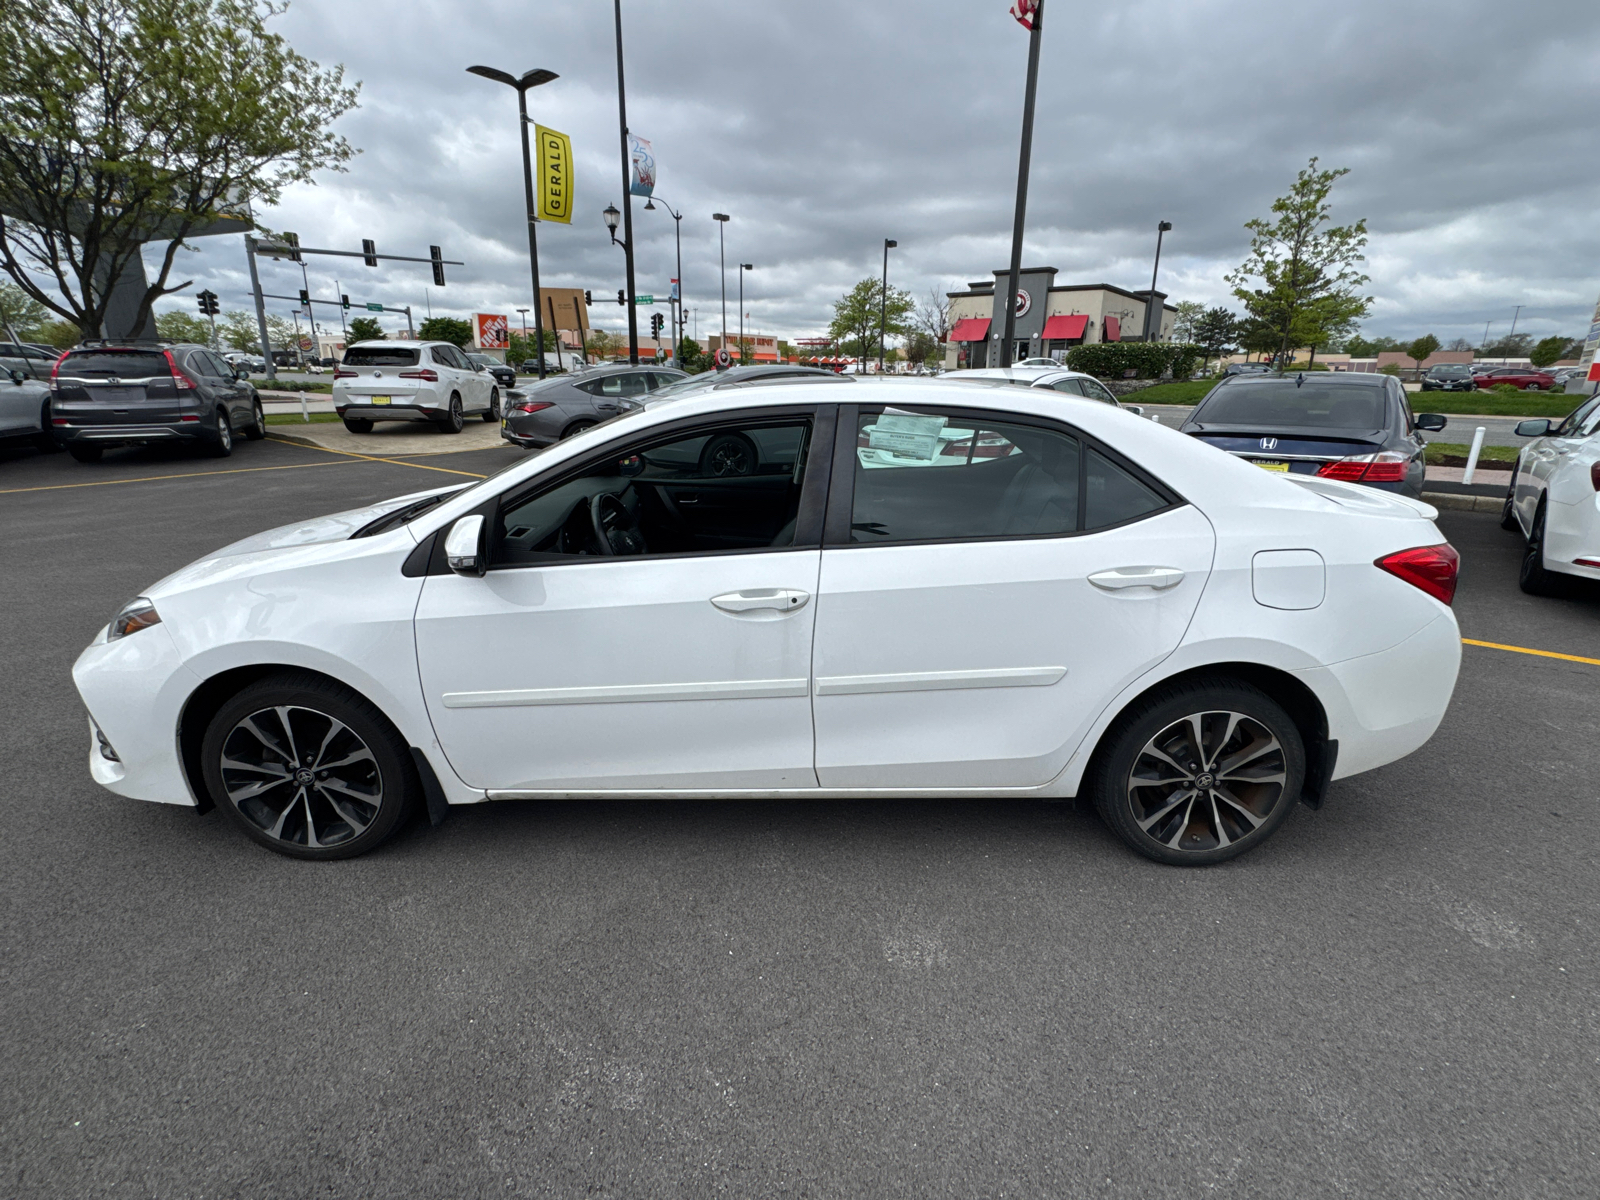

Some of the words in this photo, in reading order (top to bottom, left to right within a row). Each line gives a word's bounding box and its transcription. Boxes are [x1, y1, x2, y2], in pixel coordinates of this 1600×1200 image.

[630, 139, 654, 168] 250
[549, 140, 561, 210] GERALD
[480, 316, 506, 347] HOME
[482, 318, 494, 332] THE
